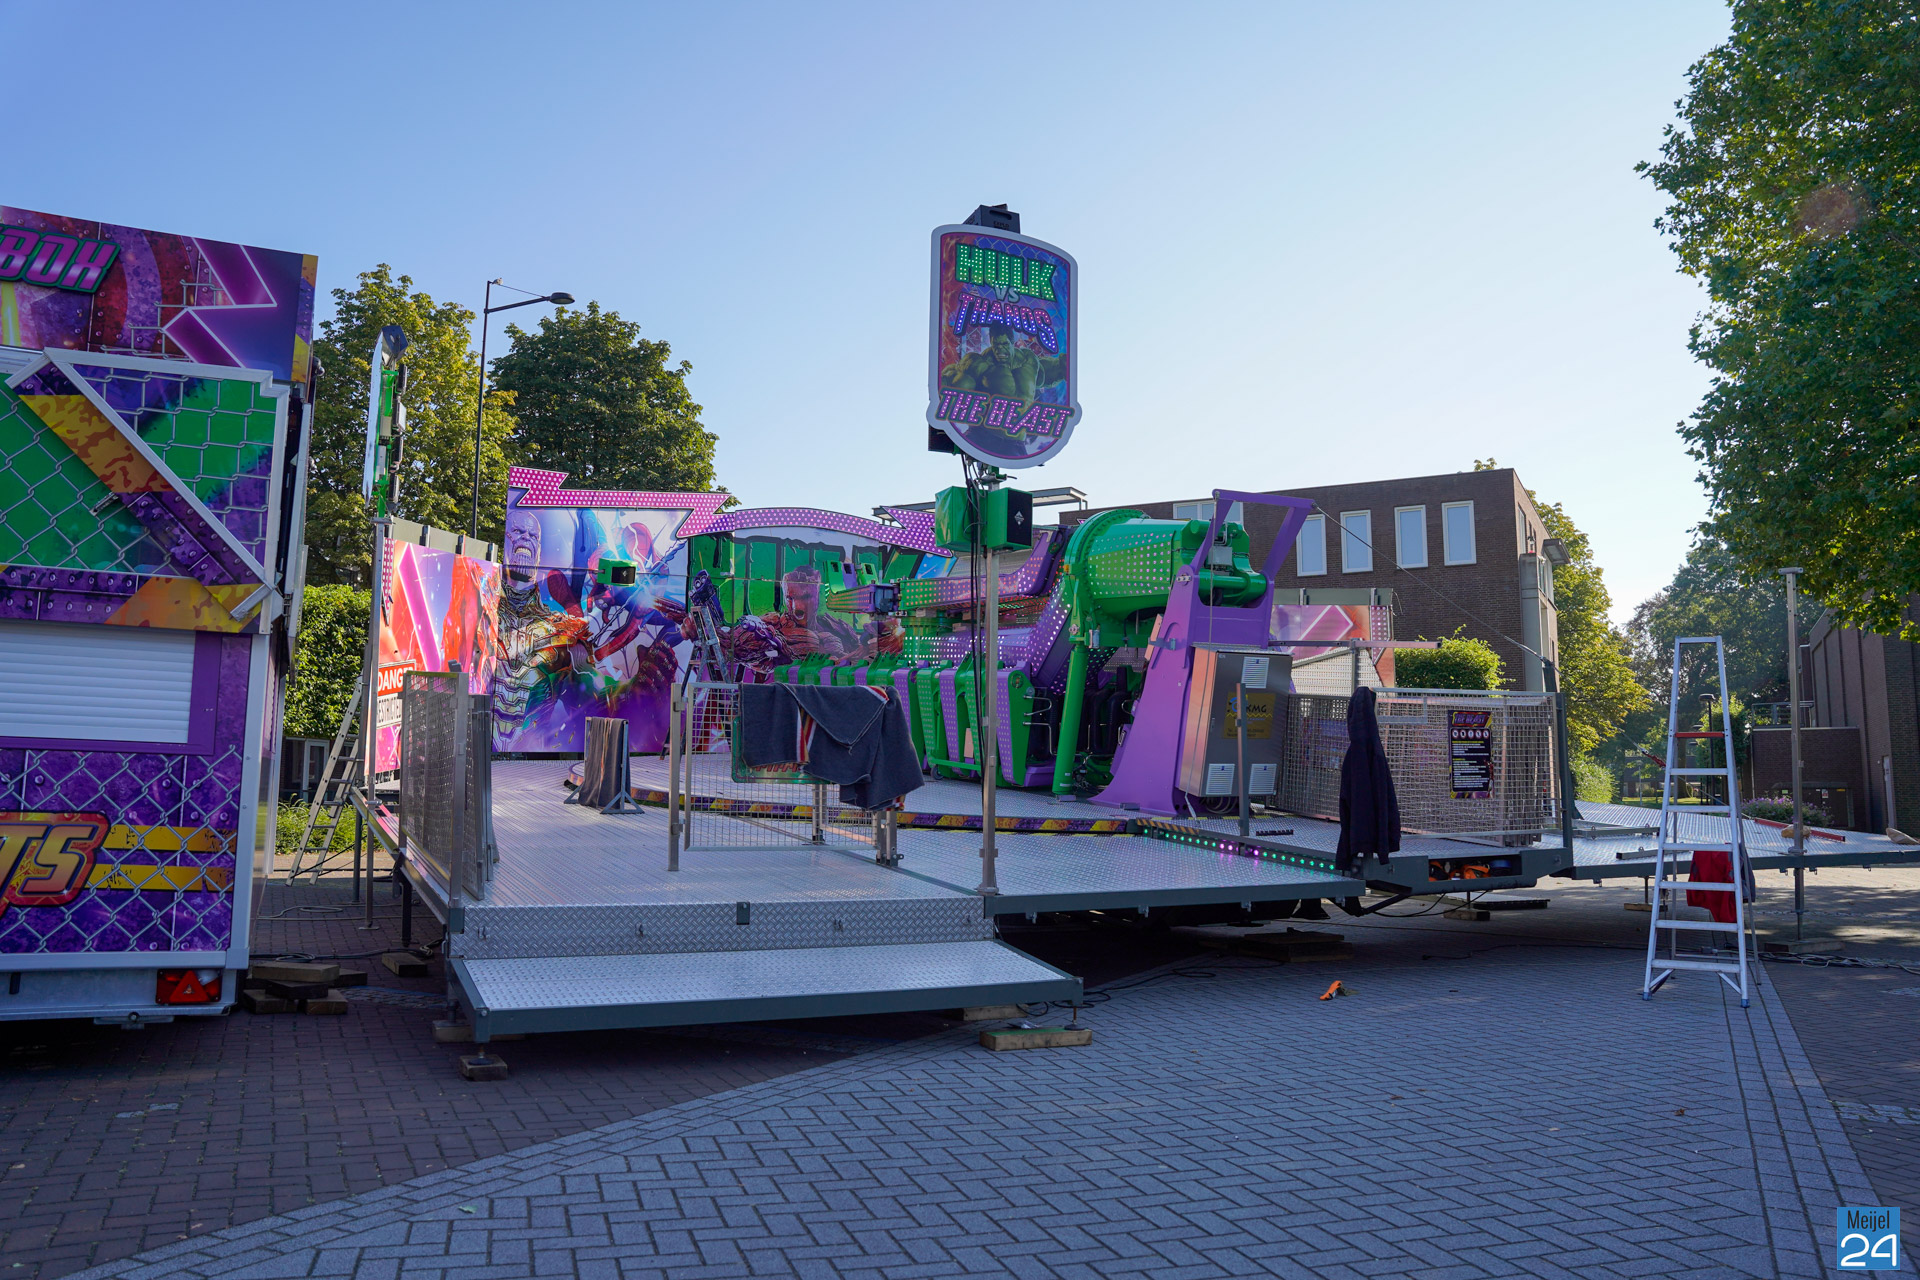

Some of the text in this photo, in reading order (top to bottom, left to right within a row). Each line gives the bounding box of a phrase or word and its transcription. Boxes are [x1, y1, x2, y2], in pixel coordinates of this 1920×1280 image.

[0, 225, 118, 291] BOX
[955, 244, 1057, 301] HULK
[953, 292, 1058, 354] THANOS
[936, 389, 1074, 438] THE BEAST
[378, 667, 414, 692] DANG
